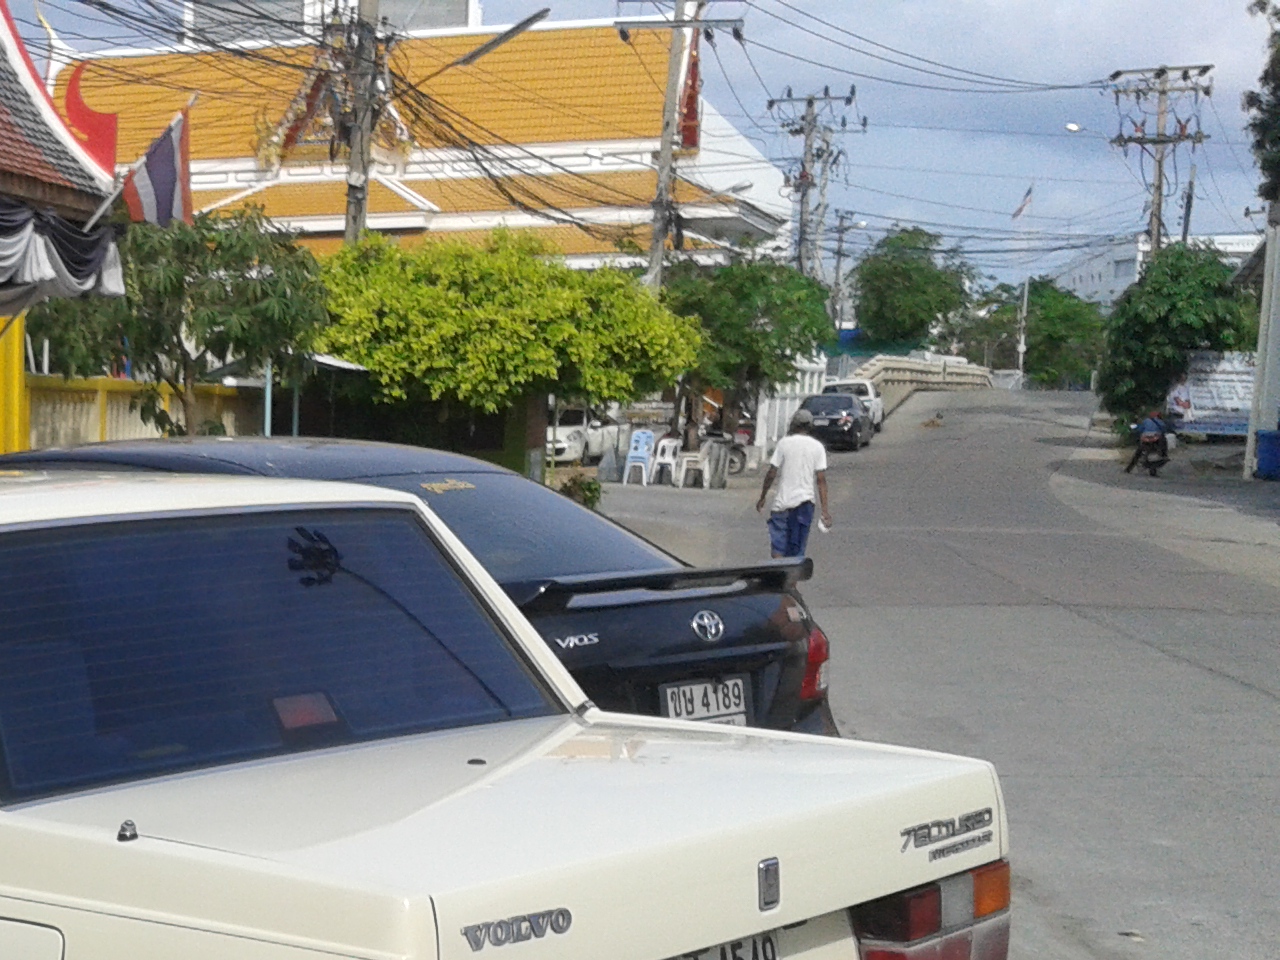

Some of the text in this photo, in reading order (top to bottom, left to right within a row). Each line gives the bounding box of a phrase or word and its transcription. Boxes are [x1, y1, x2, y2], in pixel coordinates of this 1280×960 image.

[554, 632, 600, 649] VIOS
[702, 681, 742, 713] 4189
[460, 907, 572, 952] VOLVO
